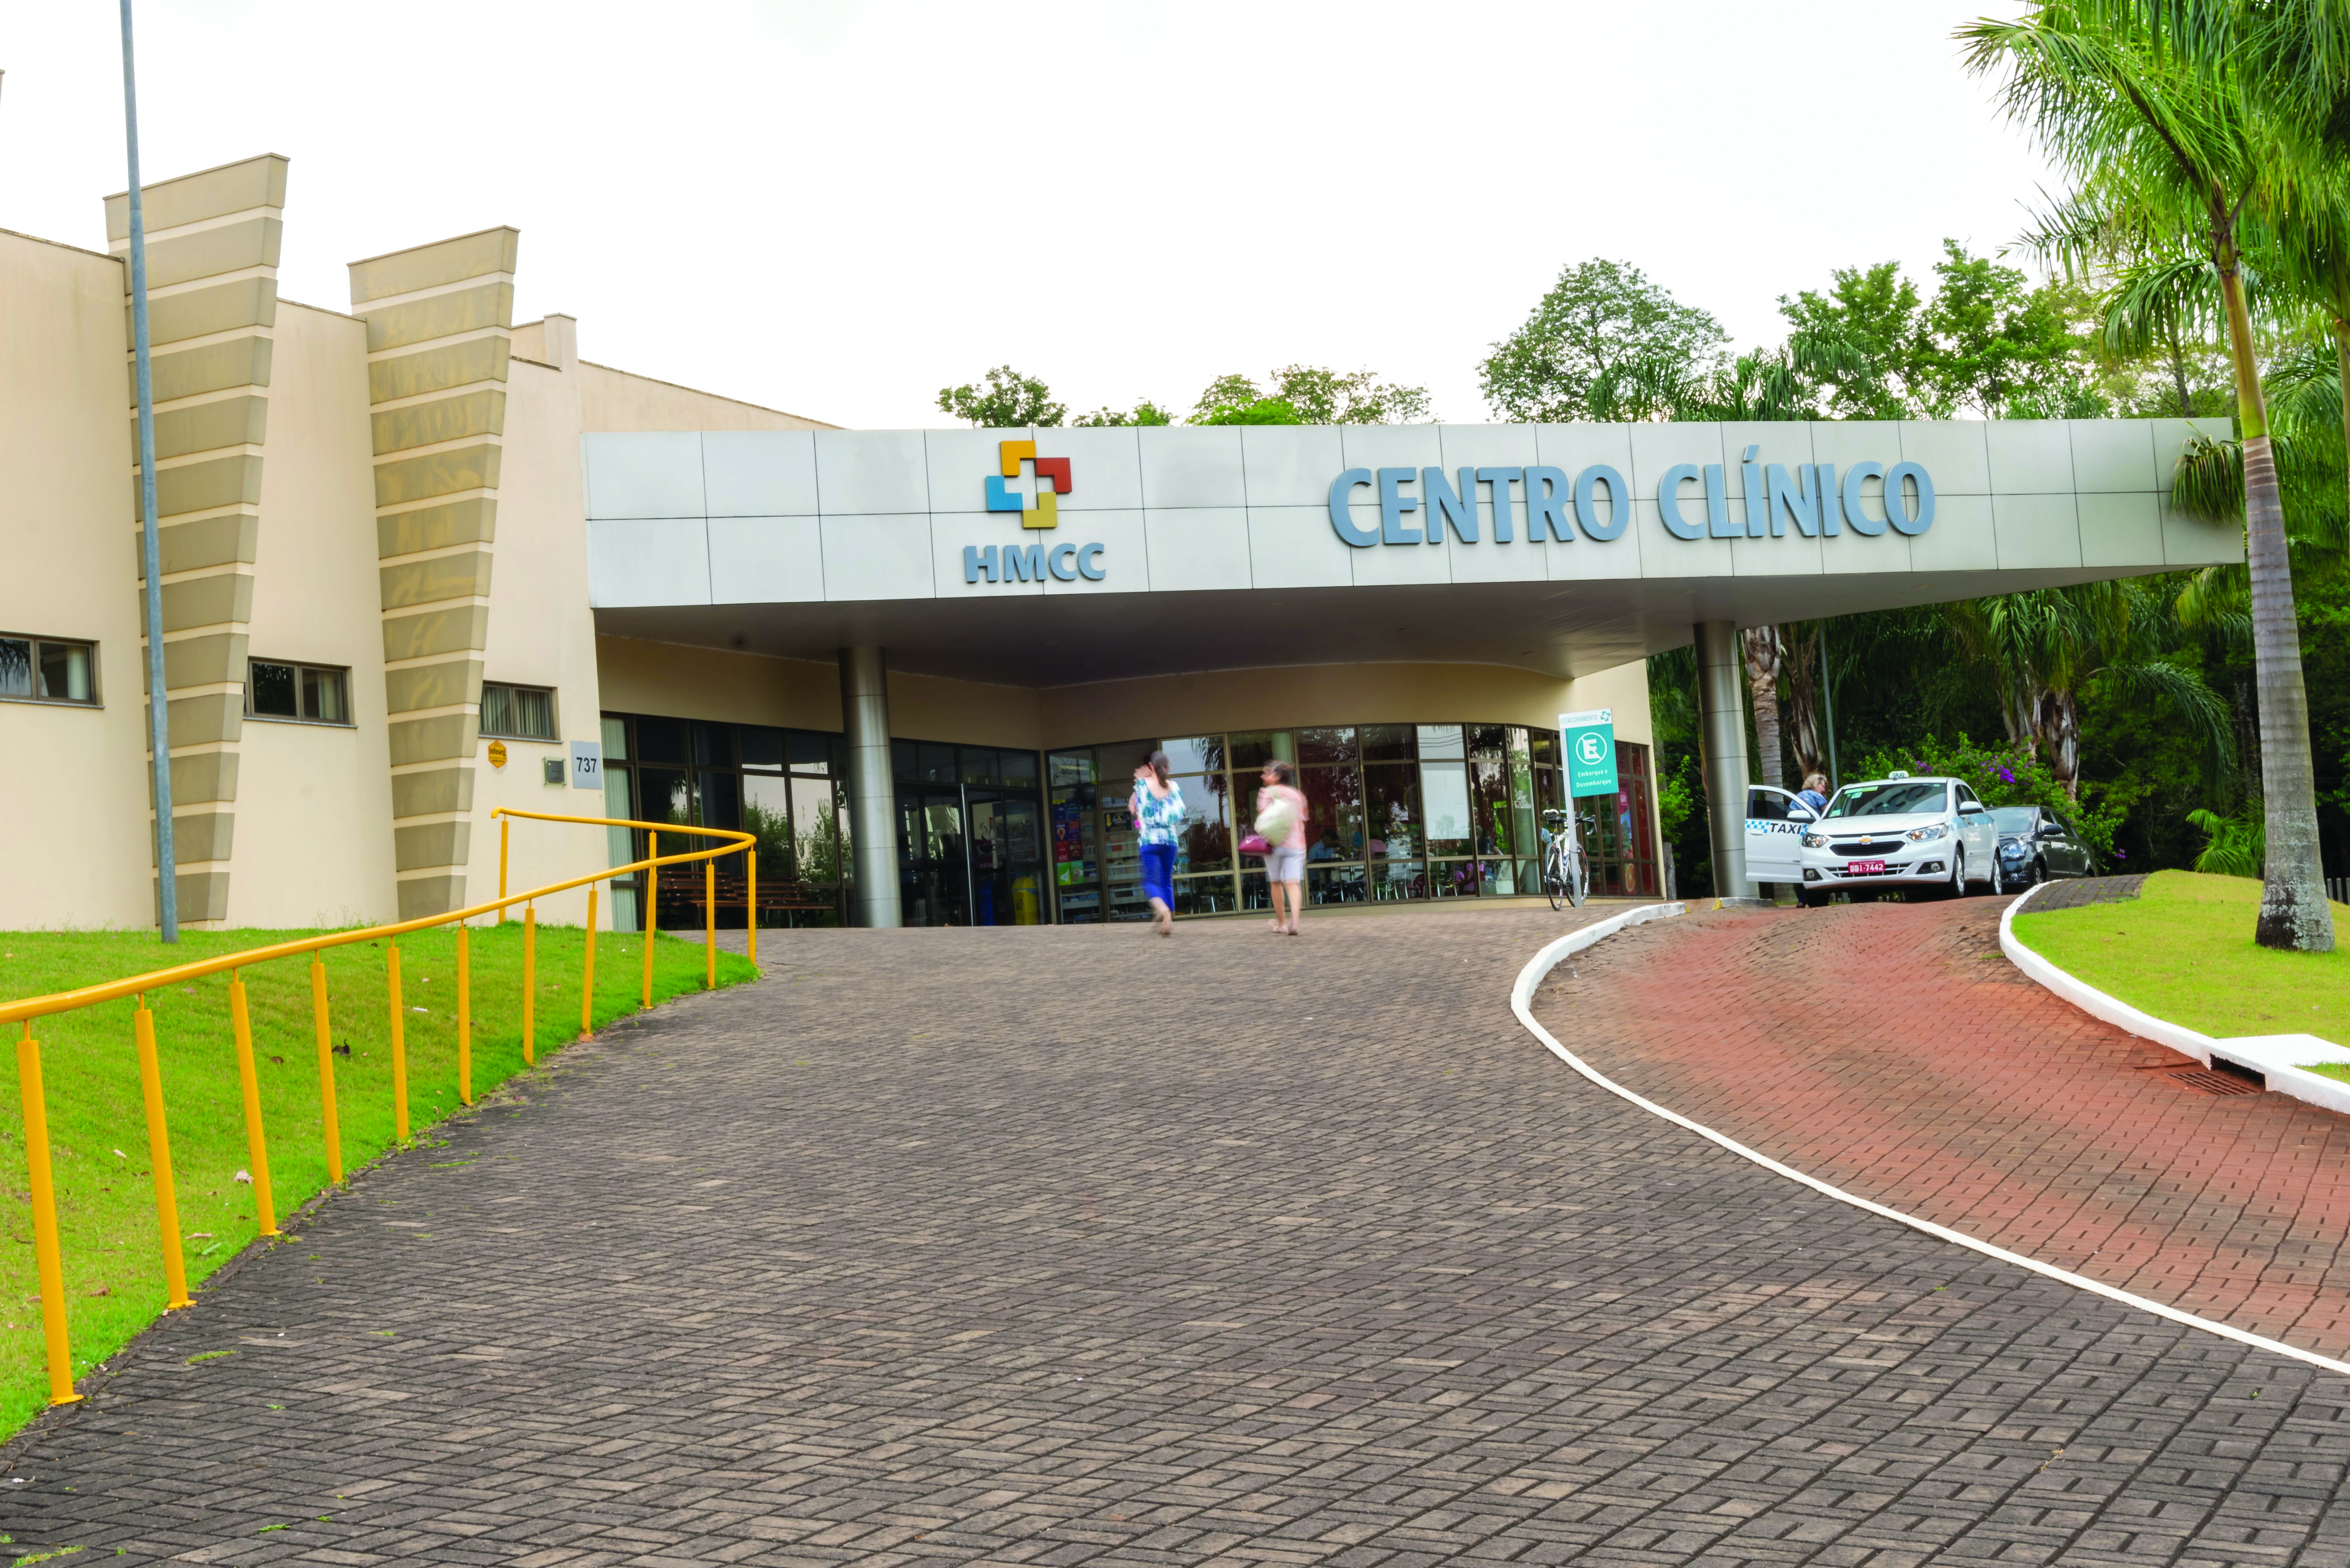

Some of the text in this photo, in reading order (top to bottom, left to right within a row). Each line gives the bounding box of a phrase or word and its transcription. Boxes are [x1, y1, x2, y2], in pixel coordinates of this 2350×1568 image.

[1329, 445, 1935, 547] CENTRO CLÍNICO
[964, 543, 1106, 583] HMCC
[1560, 714, 1597, 724] ESTACIONAMENTO
[576, 757, 597, 773] 737
[1576, 779, 1612, 788] Desembarque
[1770, 823, 1802, 834] TAXI
